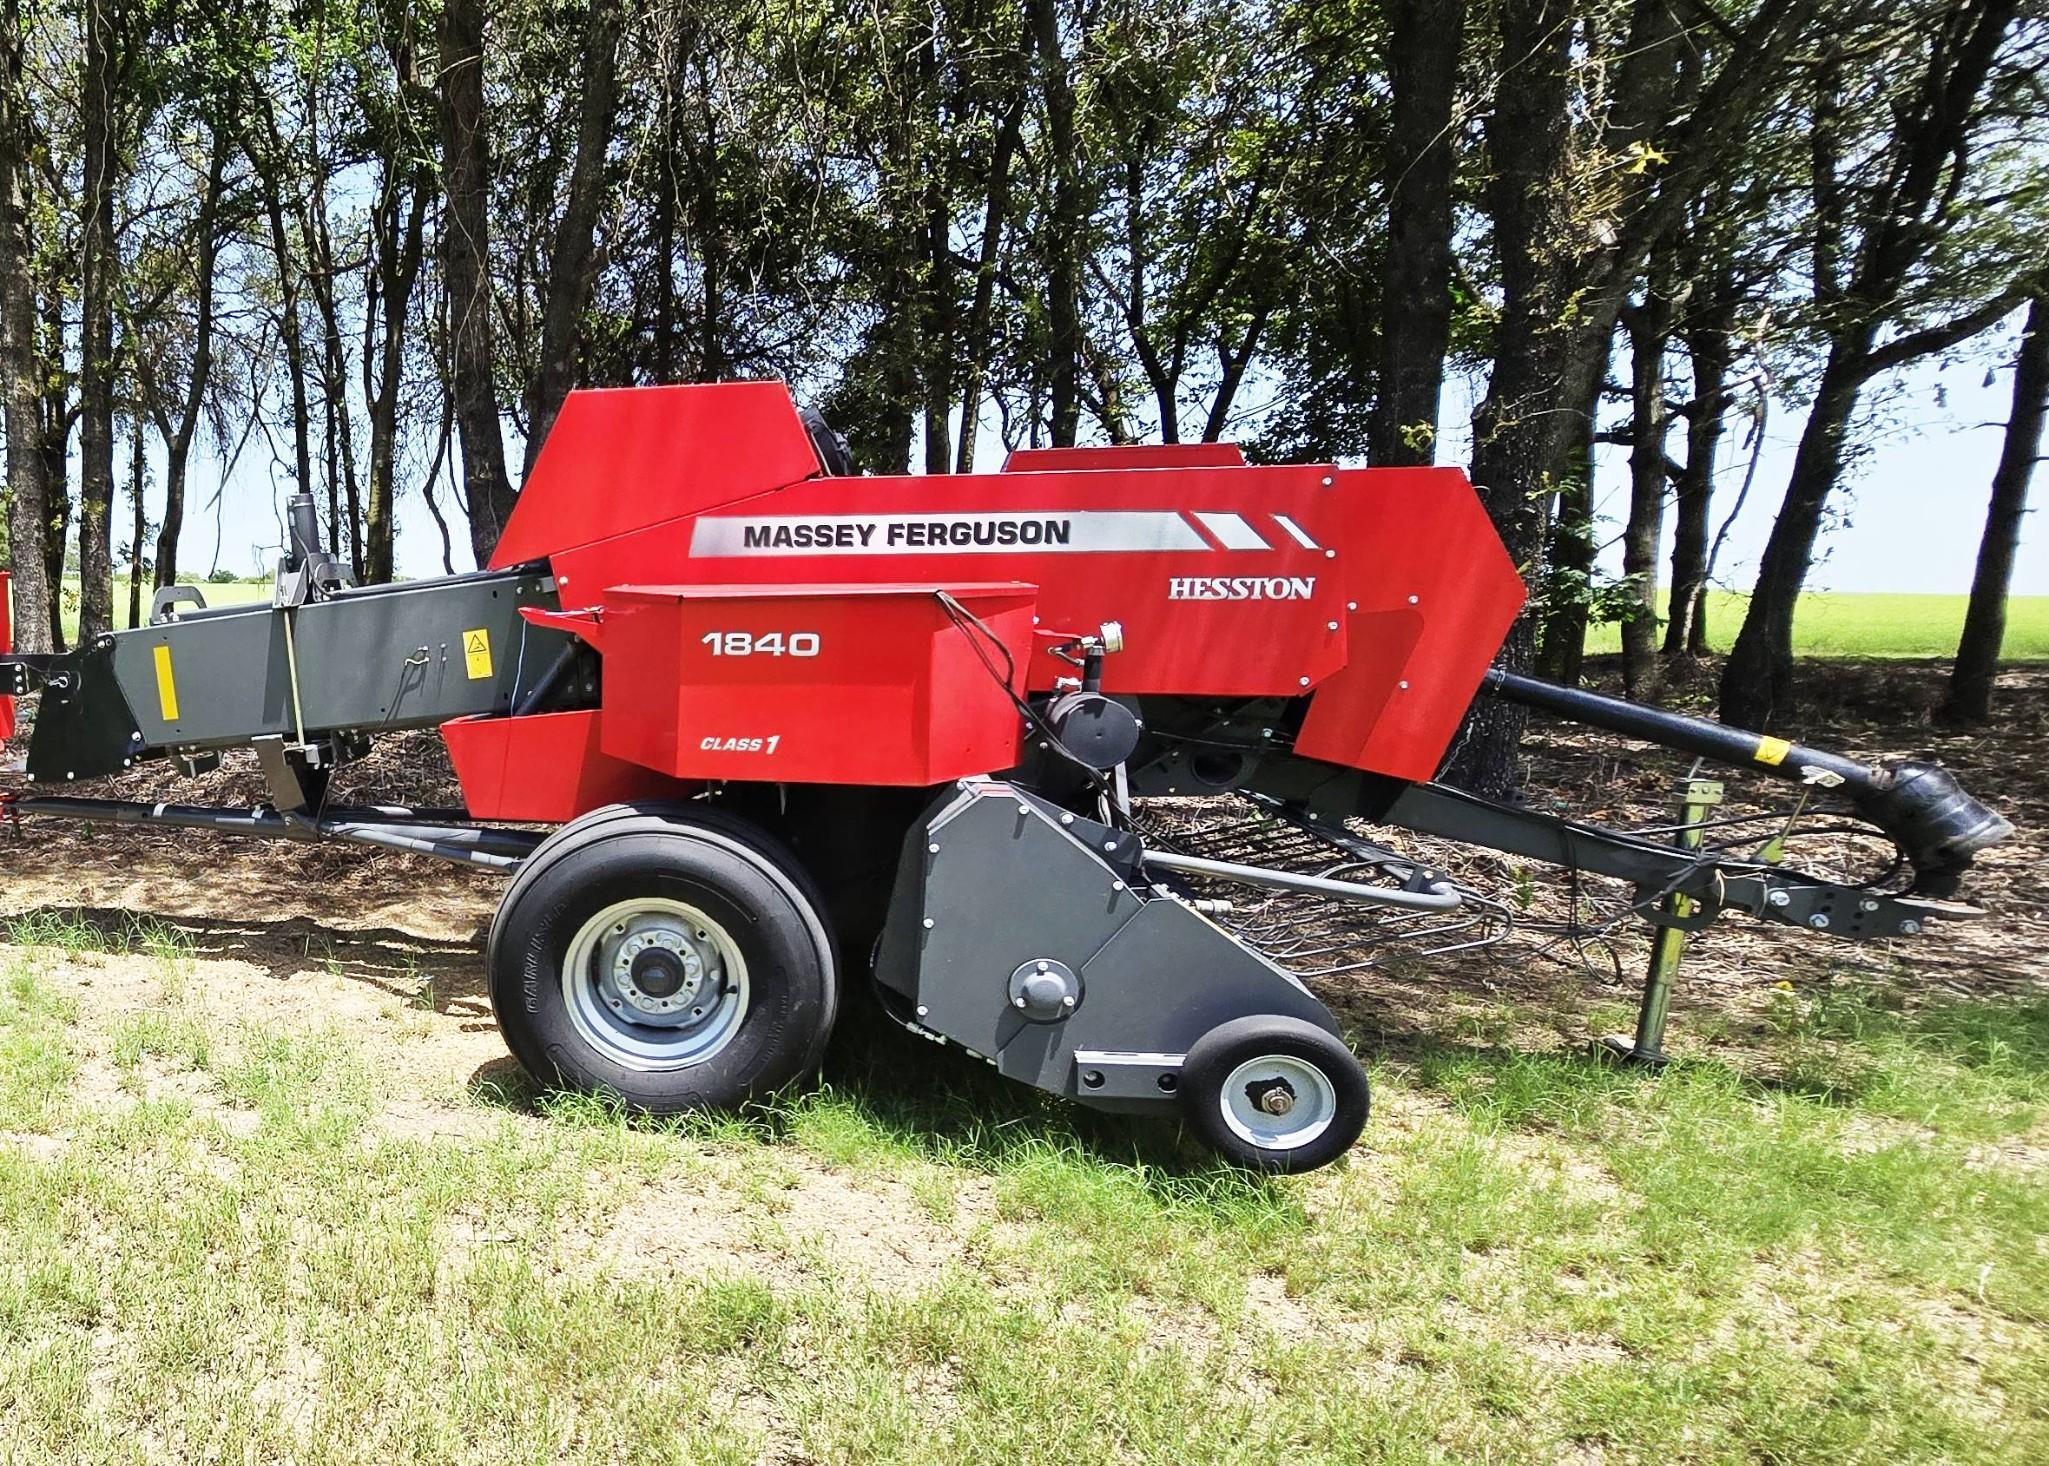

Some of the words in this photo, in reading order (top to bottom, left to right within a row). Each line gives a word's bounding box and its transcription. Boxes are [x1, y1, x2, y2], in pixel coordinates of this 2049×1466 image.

[743, 523, 876, 548] MASSEY
[886, 519, 1070, 546] FERGUSON
[1168, 576, 1316, 600] HESSTON
[701, 631, 821, 657] 1840
[699, 736, 763, 752] CLASS
[765, 735, 781, 755] 1
